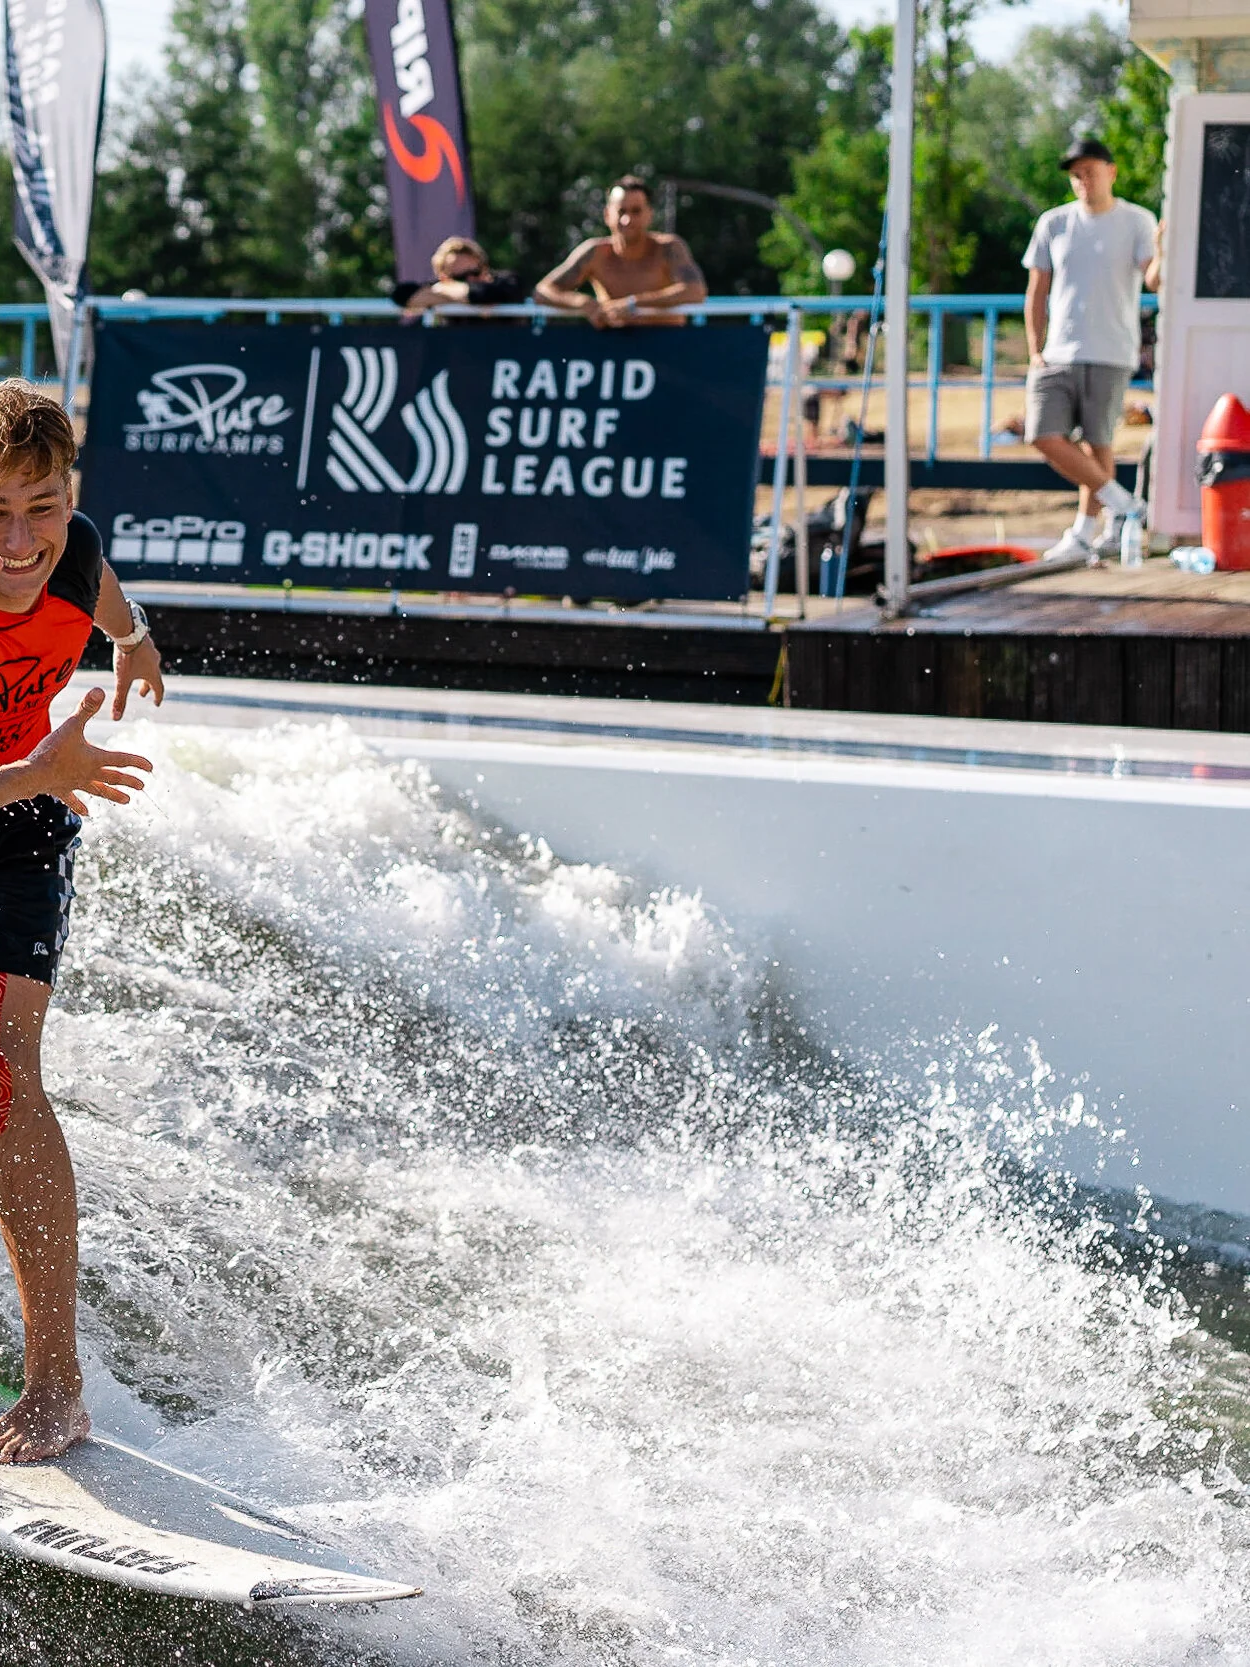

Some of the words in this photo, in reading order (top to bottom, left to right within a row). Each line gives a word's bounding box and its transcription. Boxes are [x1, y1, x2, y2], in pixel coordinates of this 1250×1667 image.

[491, 359, 656, 400] RAPID
[150, 363, 294, 445] Pure
[124, 432, 284, 454] SURFCAMPS
[484, 406, 620, 449] SURF
[481, 454, 688, 498] LEAGUE
[112, 513, 246, 541] GoPro
[262, 530, 434, 570] G-SHOCK
